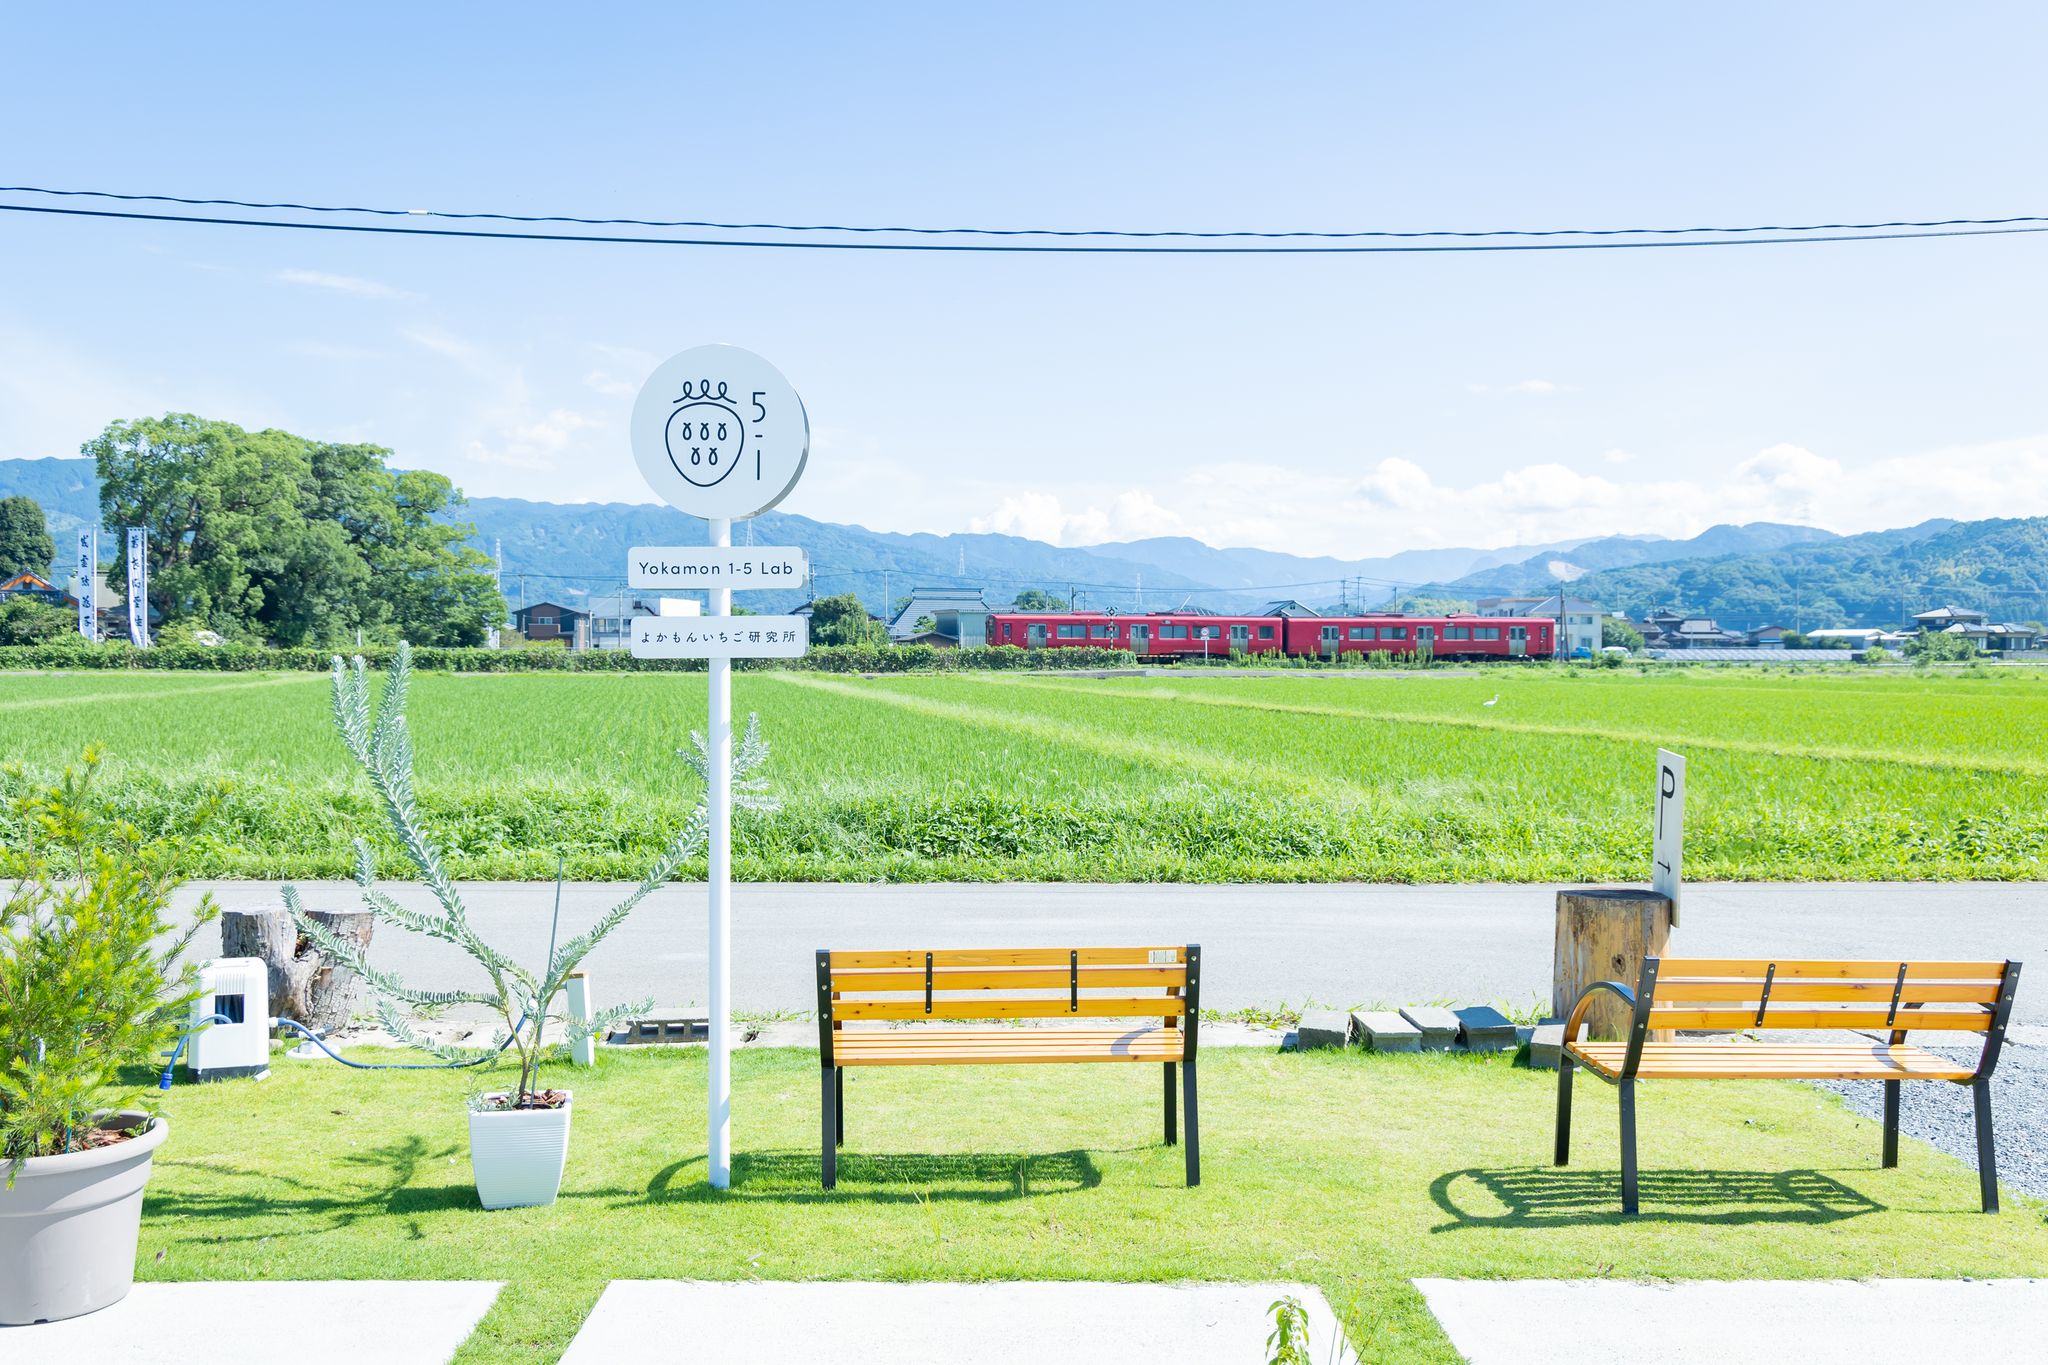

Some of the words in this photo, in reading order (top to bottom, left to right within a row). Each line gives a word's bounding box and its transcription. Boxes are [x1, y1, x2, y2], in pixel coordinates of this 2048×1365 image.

[638, 561, 720, 575] Yokamon
[728, 562, 753, 575] 1-5
[761, 561, 793, 575] Lab
[641, 630, 796, 644] よかもんいちご研究所
[1659, 764, 1676, 841] P
